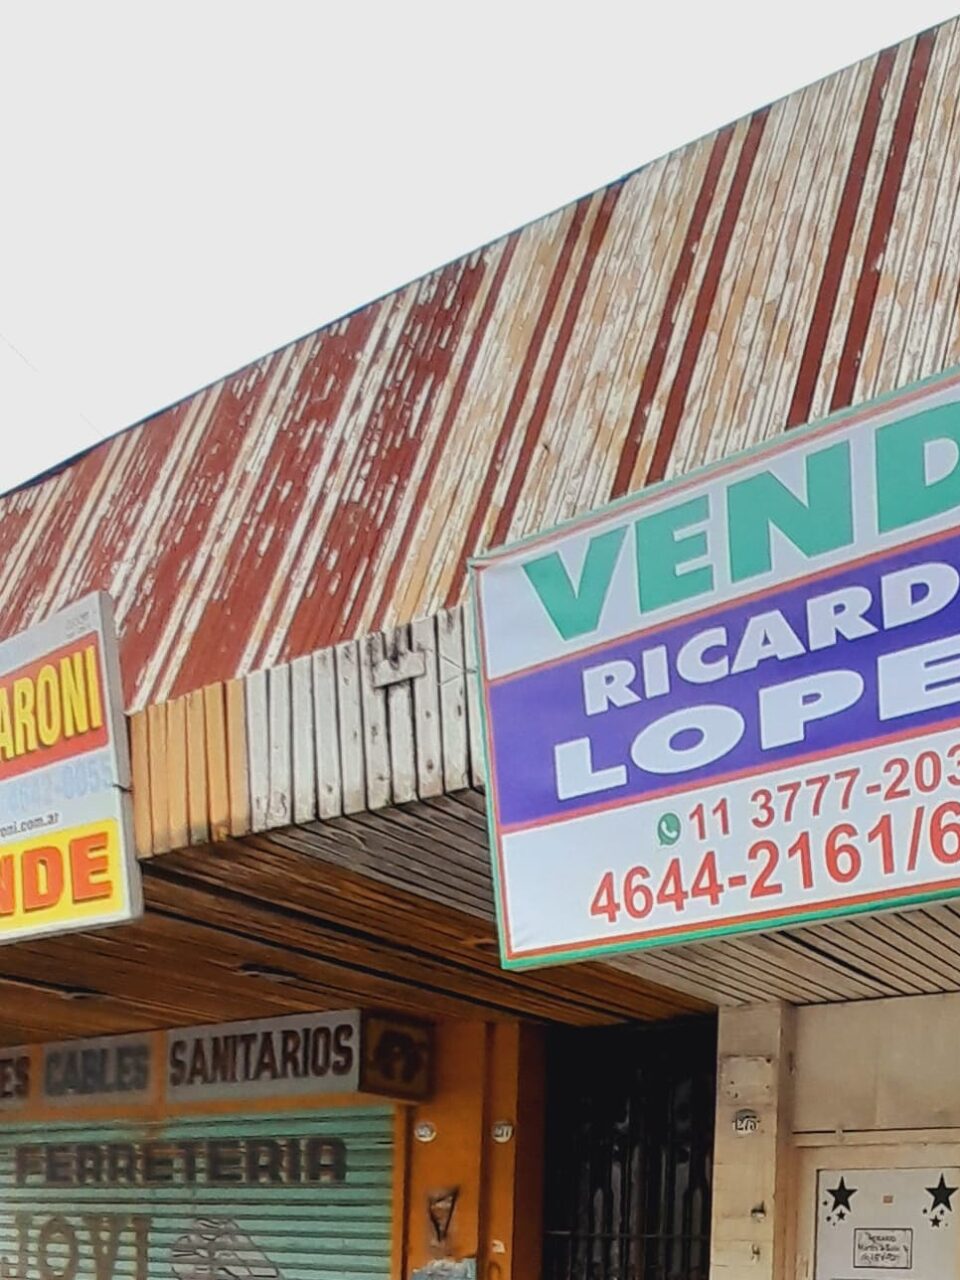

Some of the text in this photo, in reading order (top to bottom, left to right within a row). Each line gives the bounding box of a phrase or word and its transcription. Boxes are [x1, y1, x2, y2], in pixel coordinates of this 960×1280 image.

[689, 804, 731, 843] 11
[168, 1023, 354, 1087] SANITARIOS
[14, 1136, 348, 1186] FERRETERIA
